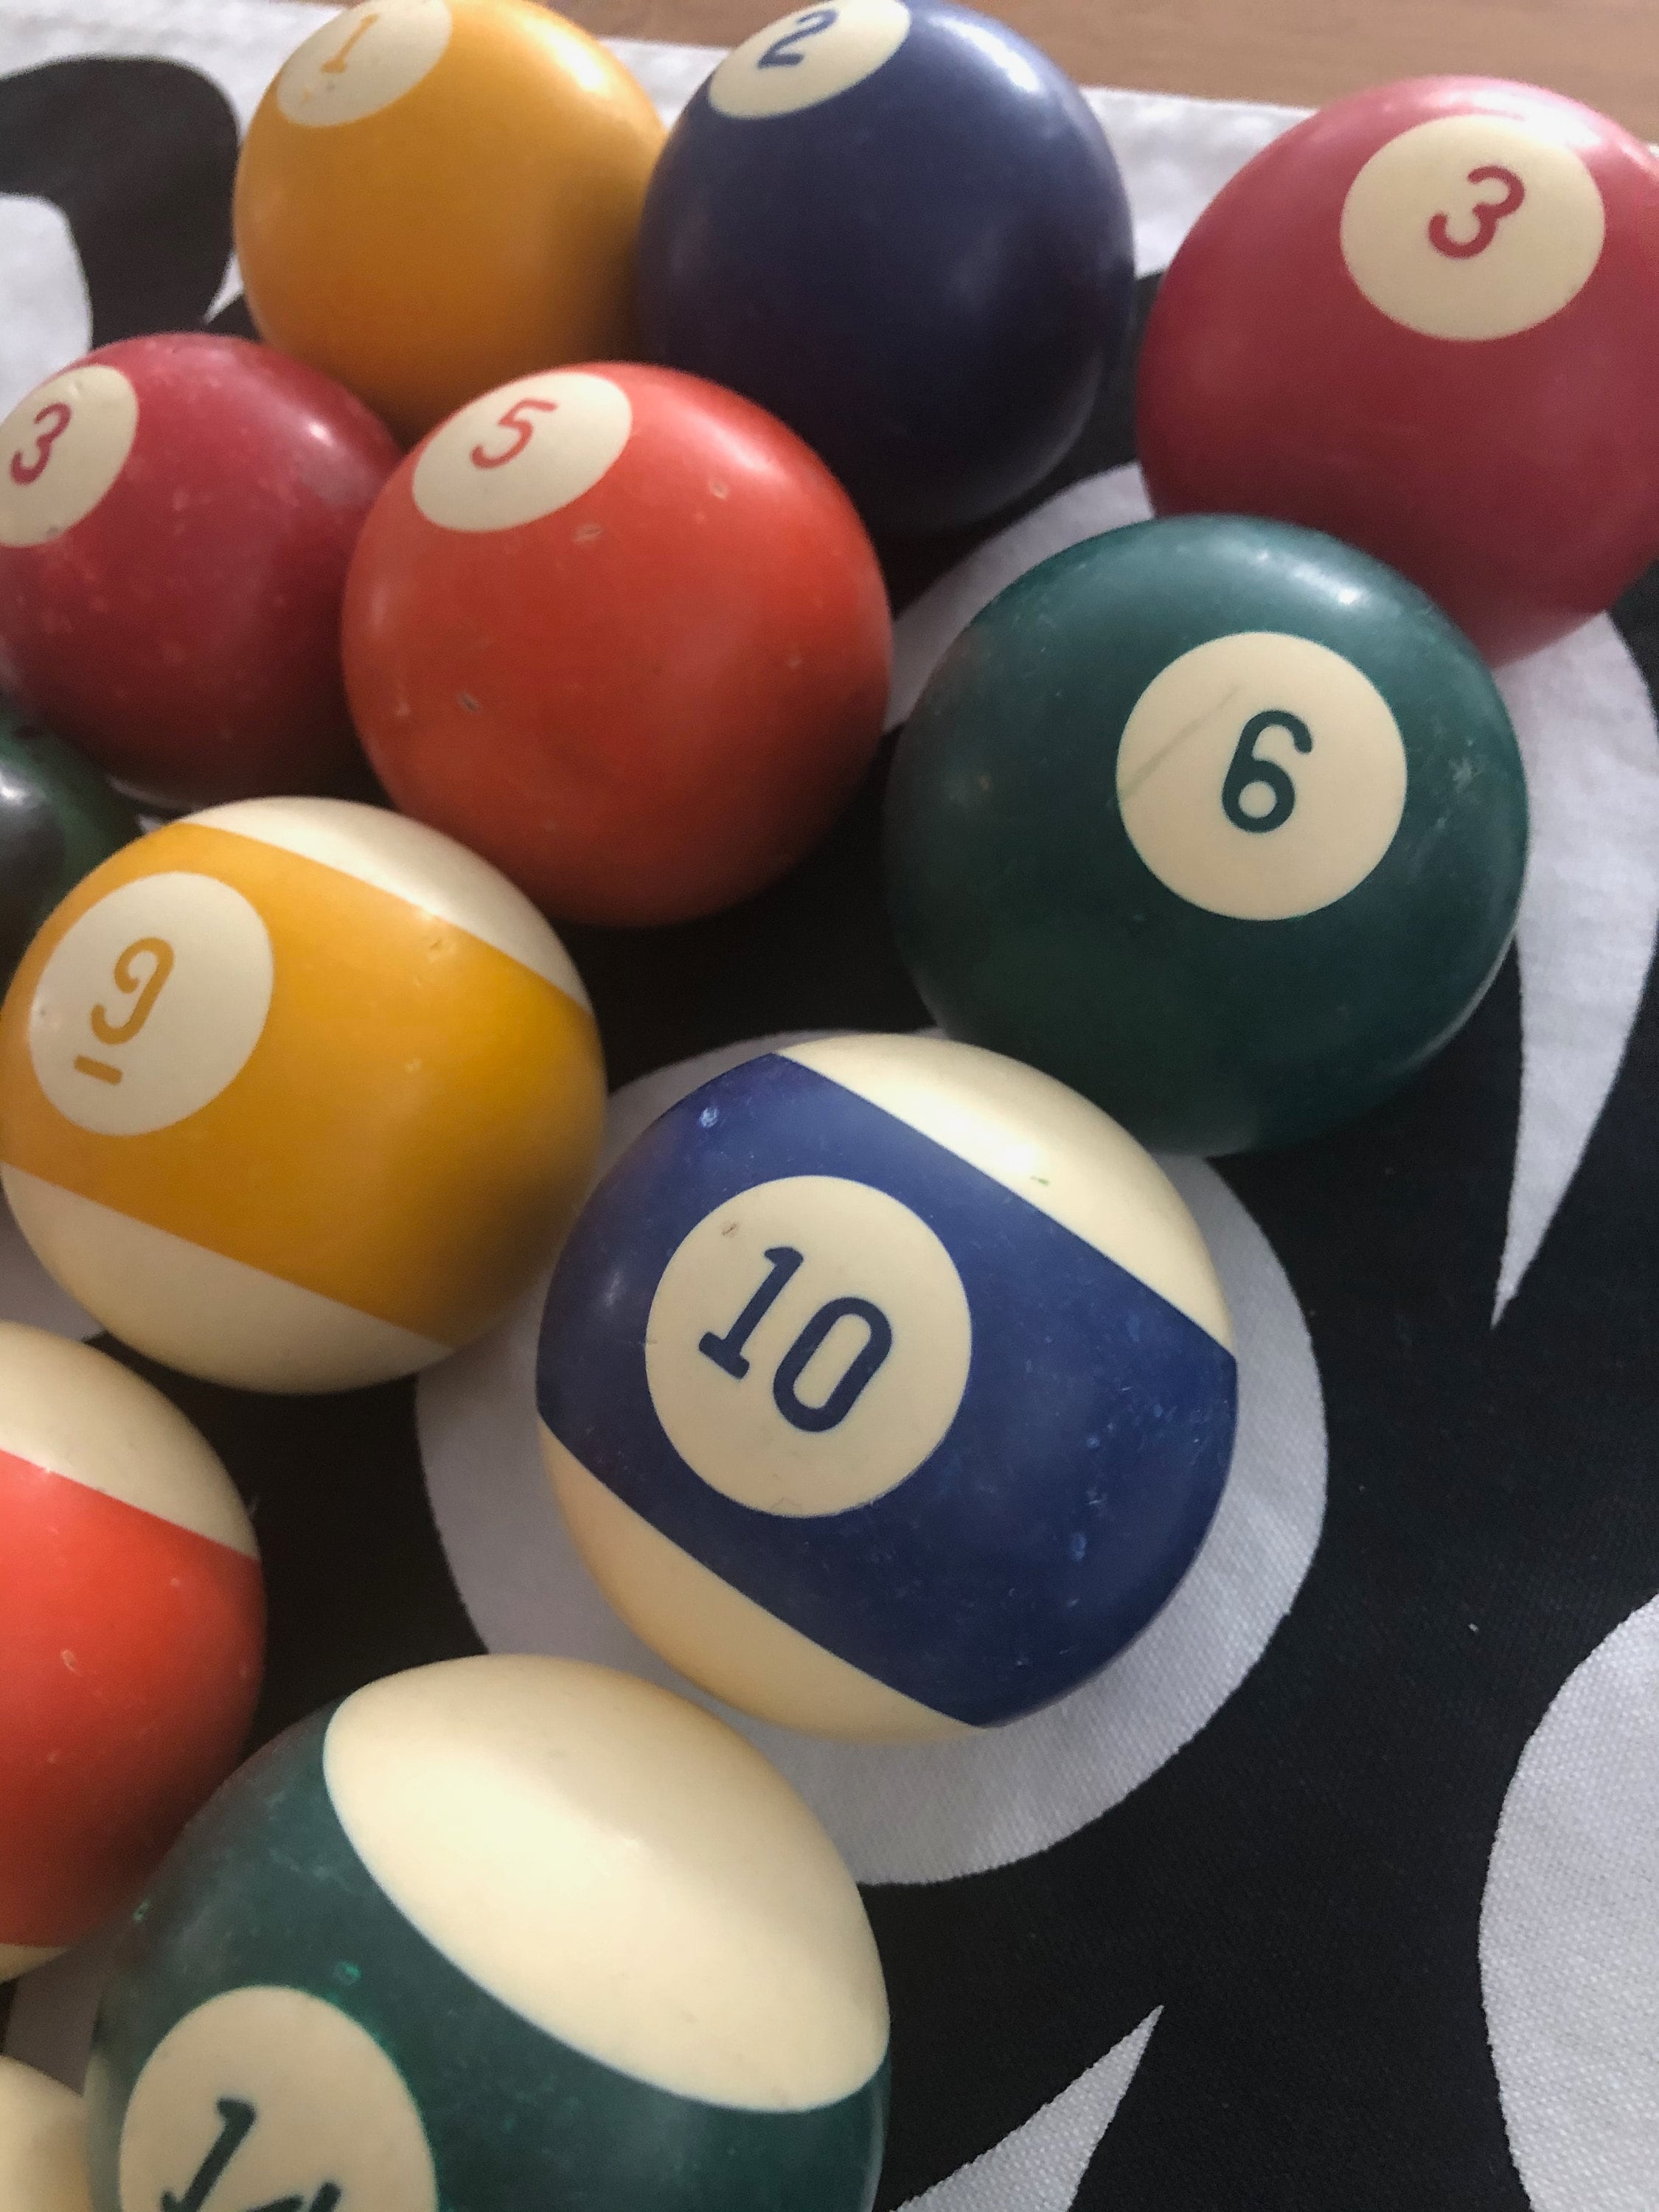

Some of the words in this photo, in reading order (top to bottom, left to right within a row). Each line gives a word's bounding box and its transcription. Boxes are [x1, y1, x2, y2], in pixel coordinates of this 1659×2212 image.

[321, 13, 379, 74] 1
[757, 8, 838, 70] 2
[1427, 165, 1525, 259] 3
[10, 403, 72, 485] 3
[470, 399, 558, 470] 5
[1222, 710, 1313, 833] 6
[88, 936, 174, 1046] 9
[698, 1246, 893, 1433] 10
[160, 2097, 341, 2212] 1
